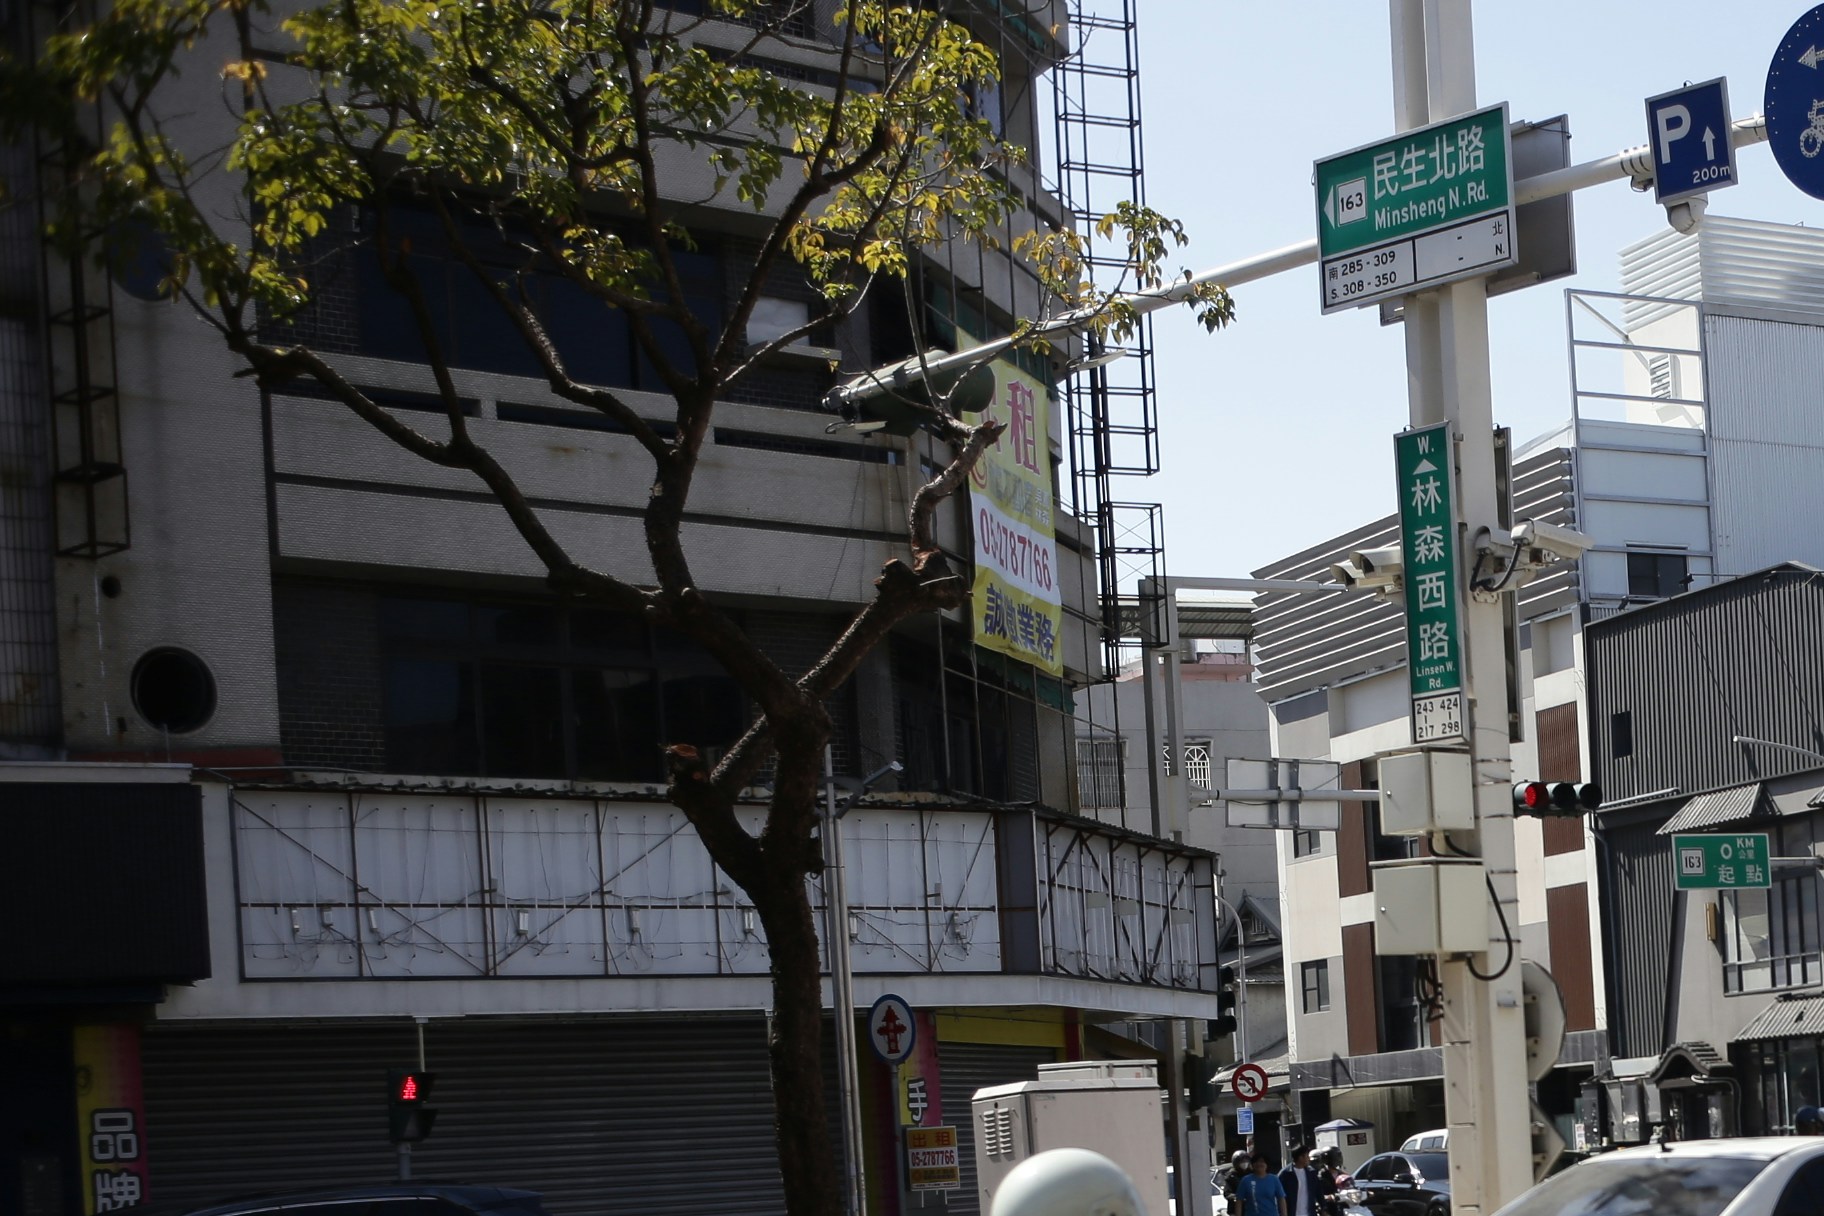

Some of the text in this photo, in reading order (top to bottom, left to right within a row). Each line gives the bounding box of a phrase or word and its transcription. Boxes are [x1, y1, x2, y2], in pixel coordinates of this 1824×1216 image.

[1656, 104, 1692, 164] P
[1373, 125, 1486, 200] 民生北路
[1692, 165, 1731, 184] 200m
[1340, 192, 1364, 213] 163
[1374, 180, 1489, 231] Minsheng N. Rd.
[1492, 221, 1504, 237] 北
[1495, 244, 1505, 256] N.
[1328, 268, 1339, 281] 南
[1331, 289, 1340, 300] S.
[1416, 436, 1435, 455] W.
[1411, 475, 1450, 662] 林森西路
[984, 583, 1055, 660] 誠徵業務
[1415, 660, 1456, 678] Linsen W.
[1428, 674, 1444, 689] Rd.
[1416, 697, 1459, 715] 243 424
[1417, 721, 1460, 739] 217 298
[1736, 837, 1754, 849] KM
[1684, 856, 1701, 869] 163
[1718, 864, 1763, 884] 起點
[908, 1080, 928, 1121] 手
[912, 1130, 951, 1148] 出租
[92, 1111, 141, 1214] 品牌
[911, 1149, 955, 1167] 05-2787766
